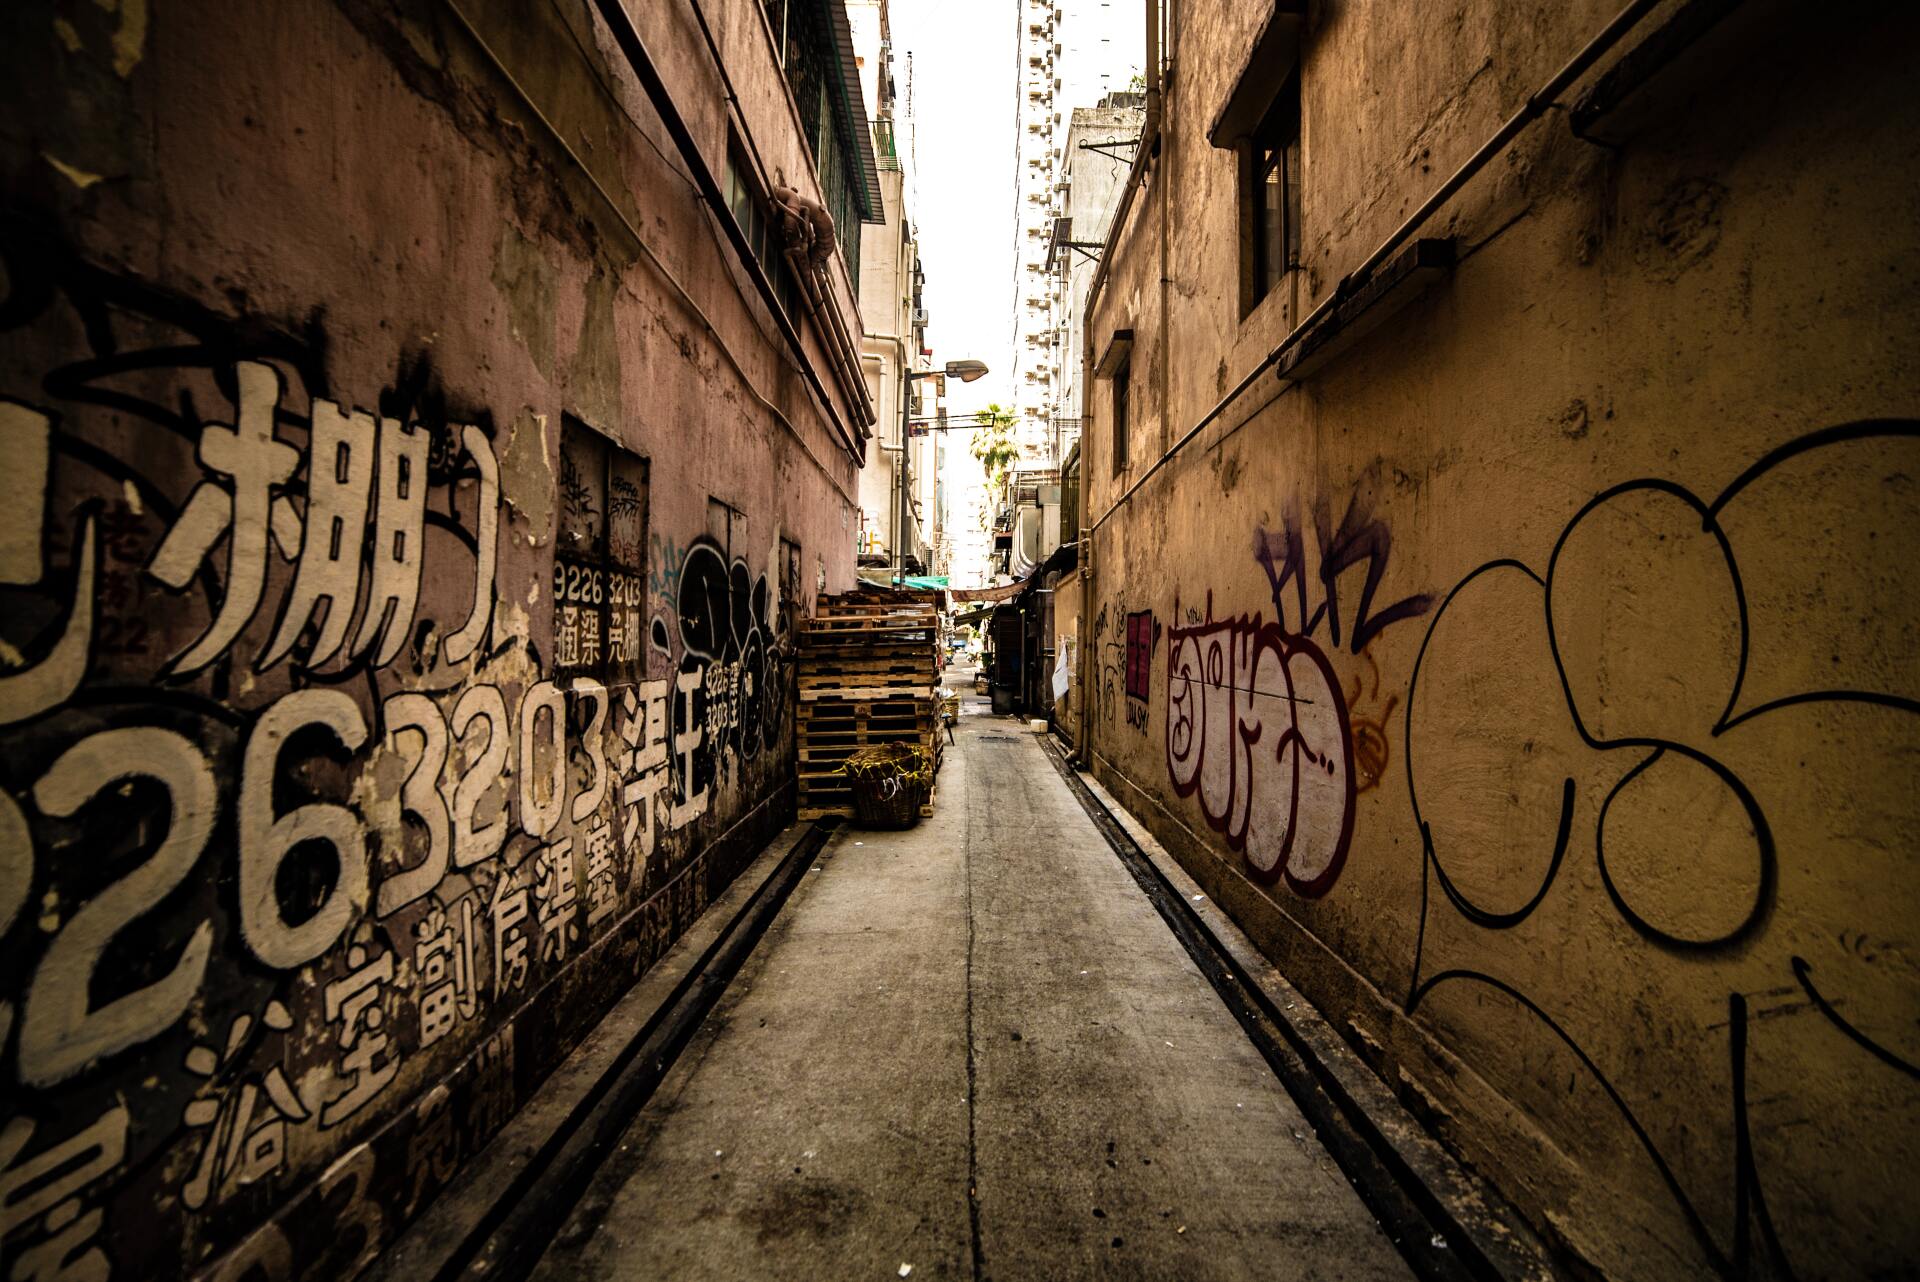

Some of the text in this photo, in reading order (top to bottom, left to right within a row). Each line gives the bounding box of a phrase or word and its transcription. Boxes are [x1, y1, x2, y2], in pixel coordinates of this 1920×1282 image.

[554, 560, 641, 607] 9226 3203
[555, 606, 641, 667] 通渠 免棚
[705, 668, 729, 700] 9226
[705, 701, 728, 735] 3203
[619, 664, 709, 857] 渠王
